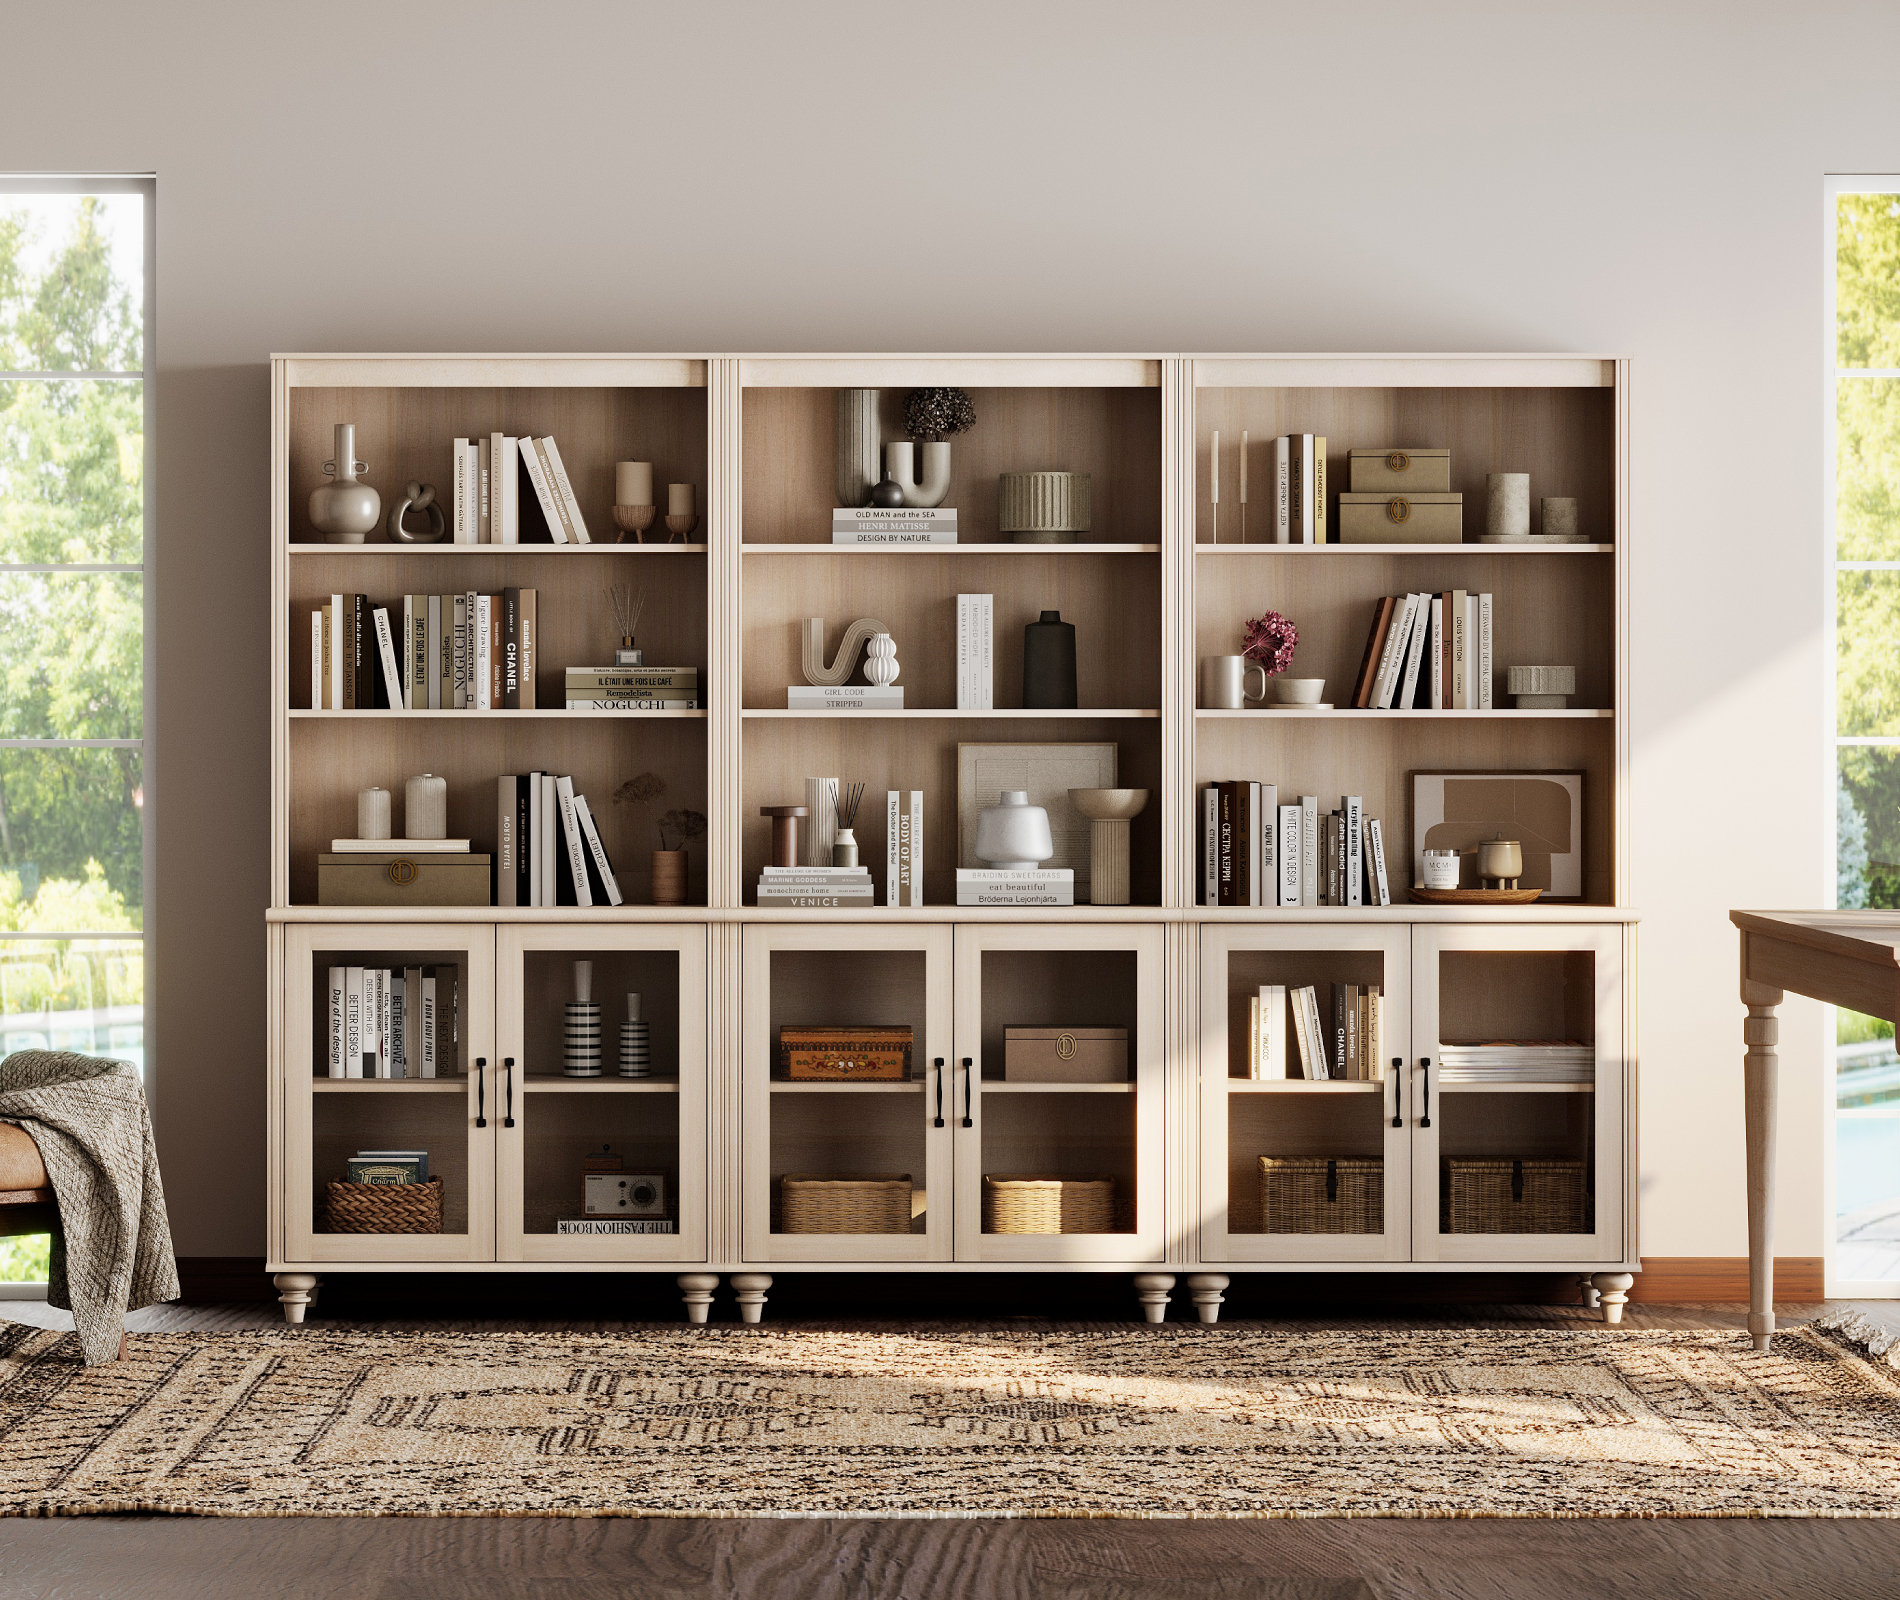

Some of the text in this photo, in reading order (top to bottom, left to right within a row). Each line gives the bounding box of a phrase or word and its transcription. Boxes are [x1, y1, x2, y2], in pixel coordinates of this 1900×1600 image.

[378, 615, 388, 649] CHANEL
[415, 618, 424, 632] CAFÉ
[479, 599, 488, 657] Figure Drawing
[415, 640, 424, 651] FOIS
[1483, 642, 1489, 650] BY
[415, 652, 424, 664] UNE
[455, 625, 465, 690] NOGUCHI
[507, 642, 516, 693] CHANEL
[415, 665, 424, 679] ÉTAIT
[604, 677, 621, 686] ÉTAIT
[622, 677, 634, 686] UNE
[635, 677, 648, 686] FOIS
[649, 677, 657, 686] LE
[657, 677, 672, 686] CAFÉ
[592, 700, 665, 709] NOGUCHI
[826, 700, 863, 708] STRIPPED
[1287, 809, 1296, 829] WHITE
[1222, 822, 1231, 853] СЕСТРА
[1287, 831, 1296, 852] COLOR
[900, 814, 909, 885] BODY OF ART
[1222, 855, 1231, 881] КЕРРИ
[1287, 862, 1296, 885] DESIGN
[791, 898, 838, 906] VENICE
[1016, 895, 1057, 904] Lejonhjärta
[331, 989, 341, 1064] Day of the design
[349, 994, 358, 1057] BETTER DESIGN
[393, 995, 401, 1064] BETTER ARCHVIZ
[439, 1003, 448, 1075] THE NEXT DESIGN
[596, 1222, 644, 1234] FASHION
[648, 1222, 672, 1234] THE
